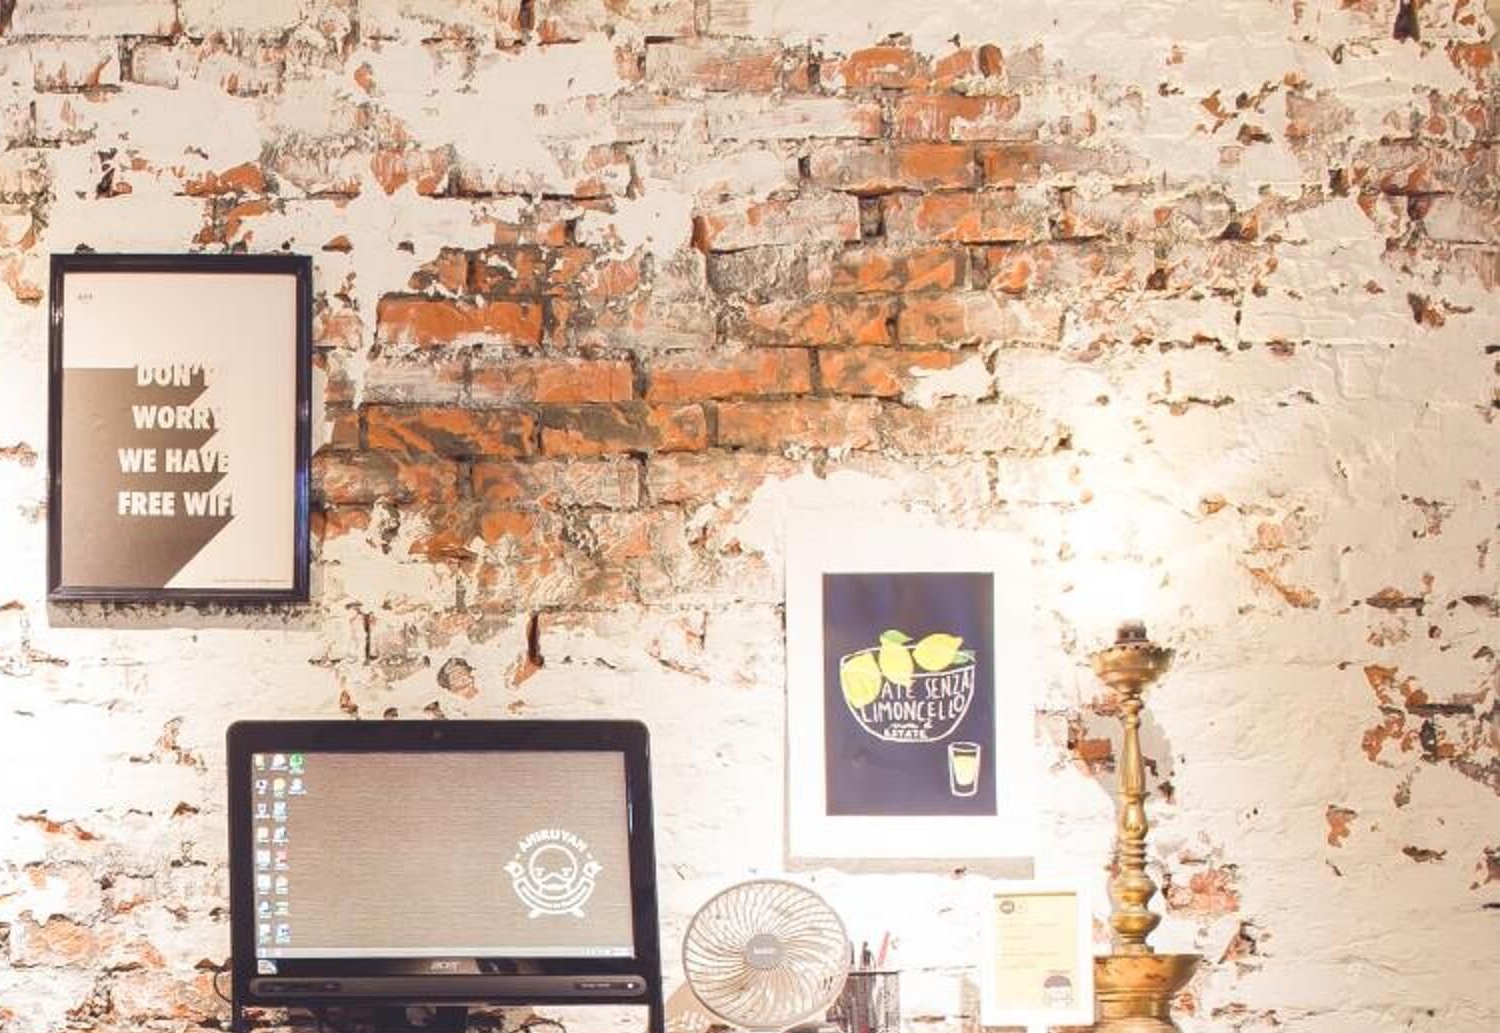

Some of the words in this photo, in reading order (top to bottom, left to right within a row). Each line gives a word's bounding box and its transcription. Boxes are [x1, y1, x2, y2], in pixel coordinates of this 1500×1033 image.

[117, 447, 157, 473] WE
[165, 447, 229, 473] HAVE
[117, 491, 176, 516] FREE
[925, 671, 970, 700] SENZA
[860, 691, 965, 724] LIMONCELLO
